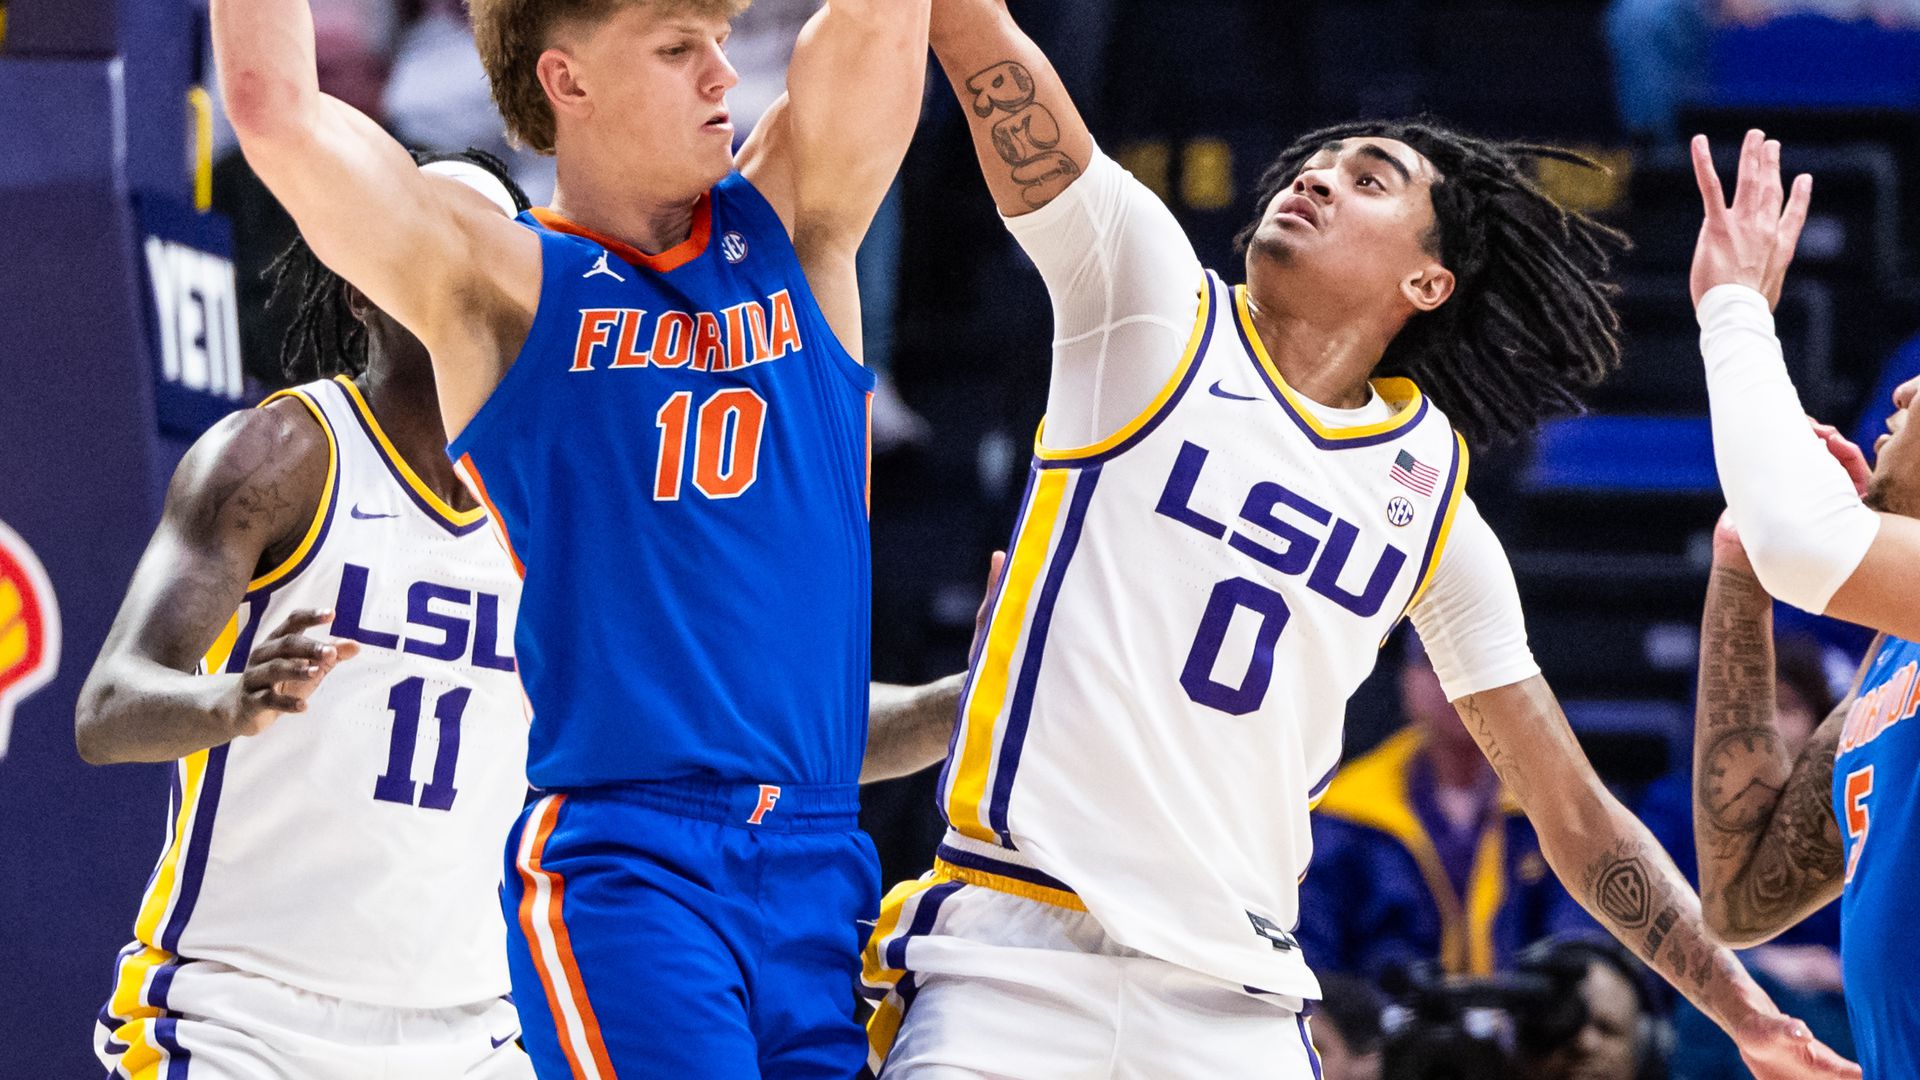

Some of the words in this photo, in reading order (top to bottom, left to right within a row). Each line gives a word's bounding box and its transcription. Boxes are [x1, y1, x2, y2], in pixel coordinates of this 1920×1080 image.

[144, 234, 244, 401] YETI
[568, 288, 803, 373] FLORIDA
[653, 387, 768, 501] 10
[1154, 439, 1408, 618] LSU
[1178, 575, 1292, 716] 0
[373, 675, 473, 812] 11
[746, 784, 781, 825] F
[1844, 764, 1874, 884] 5
